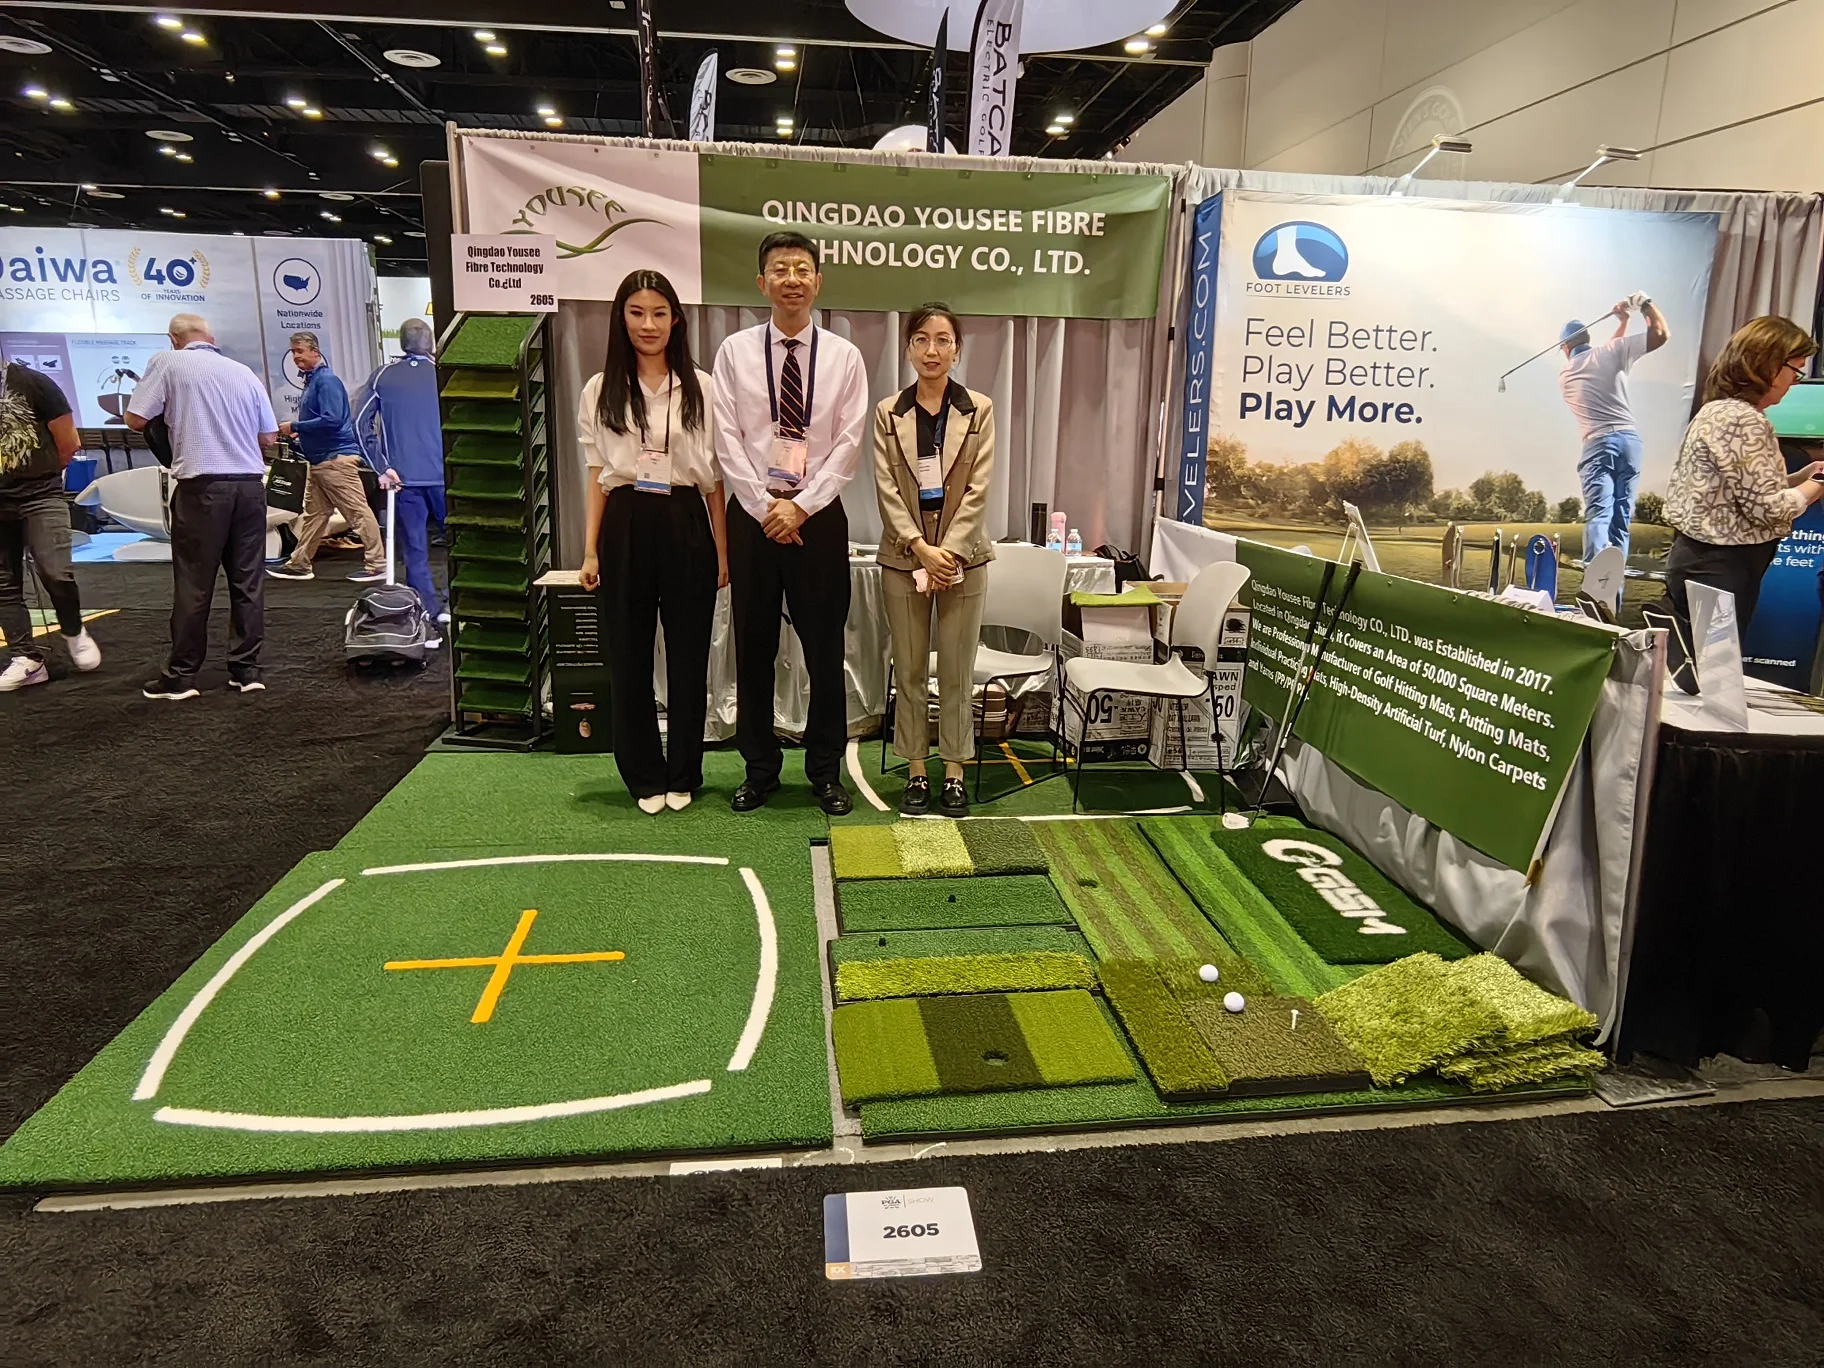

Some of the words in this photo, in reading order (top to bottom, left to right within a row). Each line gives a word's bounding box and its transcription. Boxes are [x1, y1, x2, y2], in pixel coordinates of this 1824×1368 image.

[982, 19, 995, 102] ELECTRIC
[762, 200, 906, 227] QINGDAO
[914, 206, 1023, 232] YOUSEE
[1032, 210, 1106, 237] FIBRE
[467, 246, 506, 258] Qingdao
[507, 247, 541, 258] Yousee
[811, 238, 963, 270] HNOLOGY
[971, 247, 1024, 276] CO.,
[1033, 250, 1091, 275] LTD.
[143, 257, 195, 287] 40
[466, 262, 489, 273] Fibre
[490, 262, 544, 275] Technology
[0, 288, 56, 300] ASSAGE
[61, 288, 120, 301] CHAIRS
[1246, 282, 1281, 294] FOOT
[1286, 284, 1351, 296] LEVELERS
[530, 294, 554, 306] 2605
[277, 309, 323, 318] Nationwide
[280, 321, 321, 329] Locations
[1245, 318, 1315, 349] Feel
[1327, 321, 1437, 352] Better.
[1242, 355, 1315, 391] Play
[1325, 358, 1435, 389] Better.
[1239, 392, 1316, 428] Play
[1326, 394, 1423, 424] More.
[1786, 556, 1814, 568] feet
[1251, 580, 1277, 597] Qingdao
[1277, 587, 1302, 606] Yousee
[1302, 595, 1316, 610] Fibr
[1322, 602, 1368, 632] Tecnology
[1370, 617, 1388, 638] CO.,
[1390, 624, 1412, 644] LTD.
[1414, 634, 1434, 652] was
[1435, 639, 1500, 676] Established
[1501, 661, 1515, 682] in
[1515, 667, 1554, 695] 2017.
[1248, 659, 1259, 671] and
[1252, 598, 1276, 617] Located
[1276, 608, 1284, 620] in
[1336, 629, 1343, 643] it
[1343, 633, 1372, 655] Covers
[1372, 647, 1385, 660] an
[1385, 649, 1408, 669] Area
[1409, 659, 1423, 675] of
[1422, 664, 1457, 689] 50,000
[1457, 677, 1498, 706] Square
[1500, 693, 1555, 729] Meters.
[1753, 657, 1796, 667] scanned
[1252, 617, 1261, 631] We
[1262, 624, 1272, 637] are
[1310, 642, 1362, 676] Mnufacturer
[1362, 667, 1374, 681] of
[1373, 670, 1395, 691] Golf
[1394, 679, 1428, 710] Hitting
[1429, 694, 1456, 722] Mats,
[1458, 708, 1504, 745] Putting
[1507, 728, 1551, 762] Mats,
[1328, 675, 1383, 715] High-Density
[1382, 702, 1423, 733] Artificial
[1423, 720, 1447, 748] Turf,
[1448, 734, 1486, 764] Nylon
[1488, 753, 1547, 791] Carpets
[907, 1197, 934, 1205] SHOW
[883, 1223, 939, 1239] 2605
